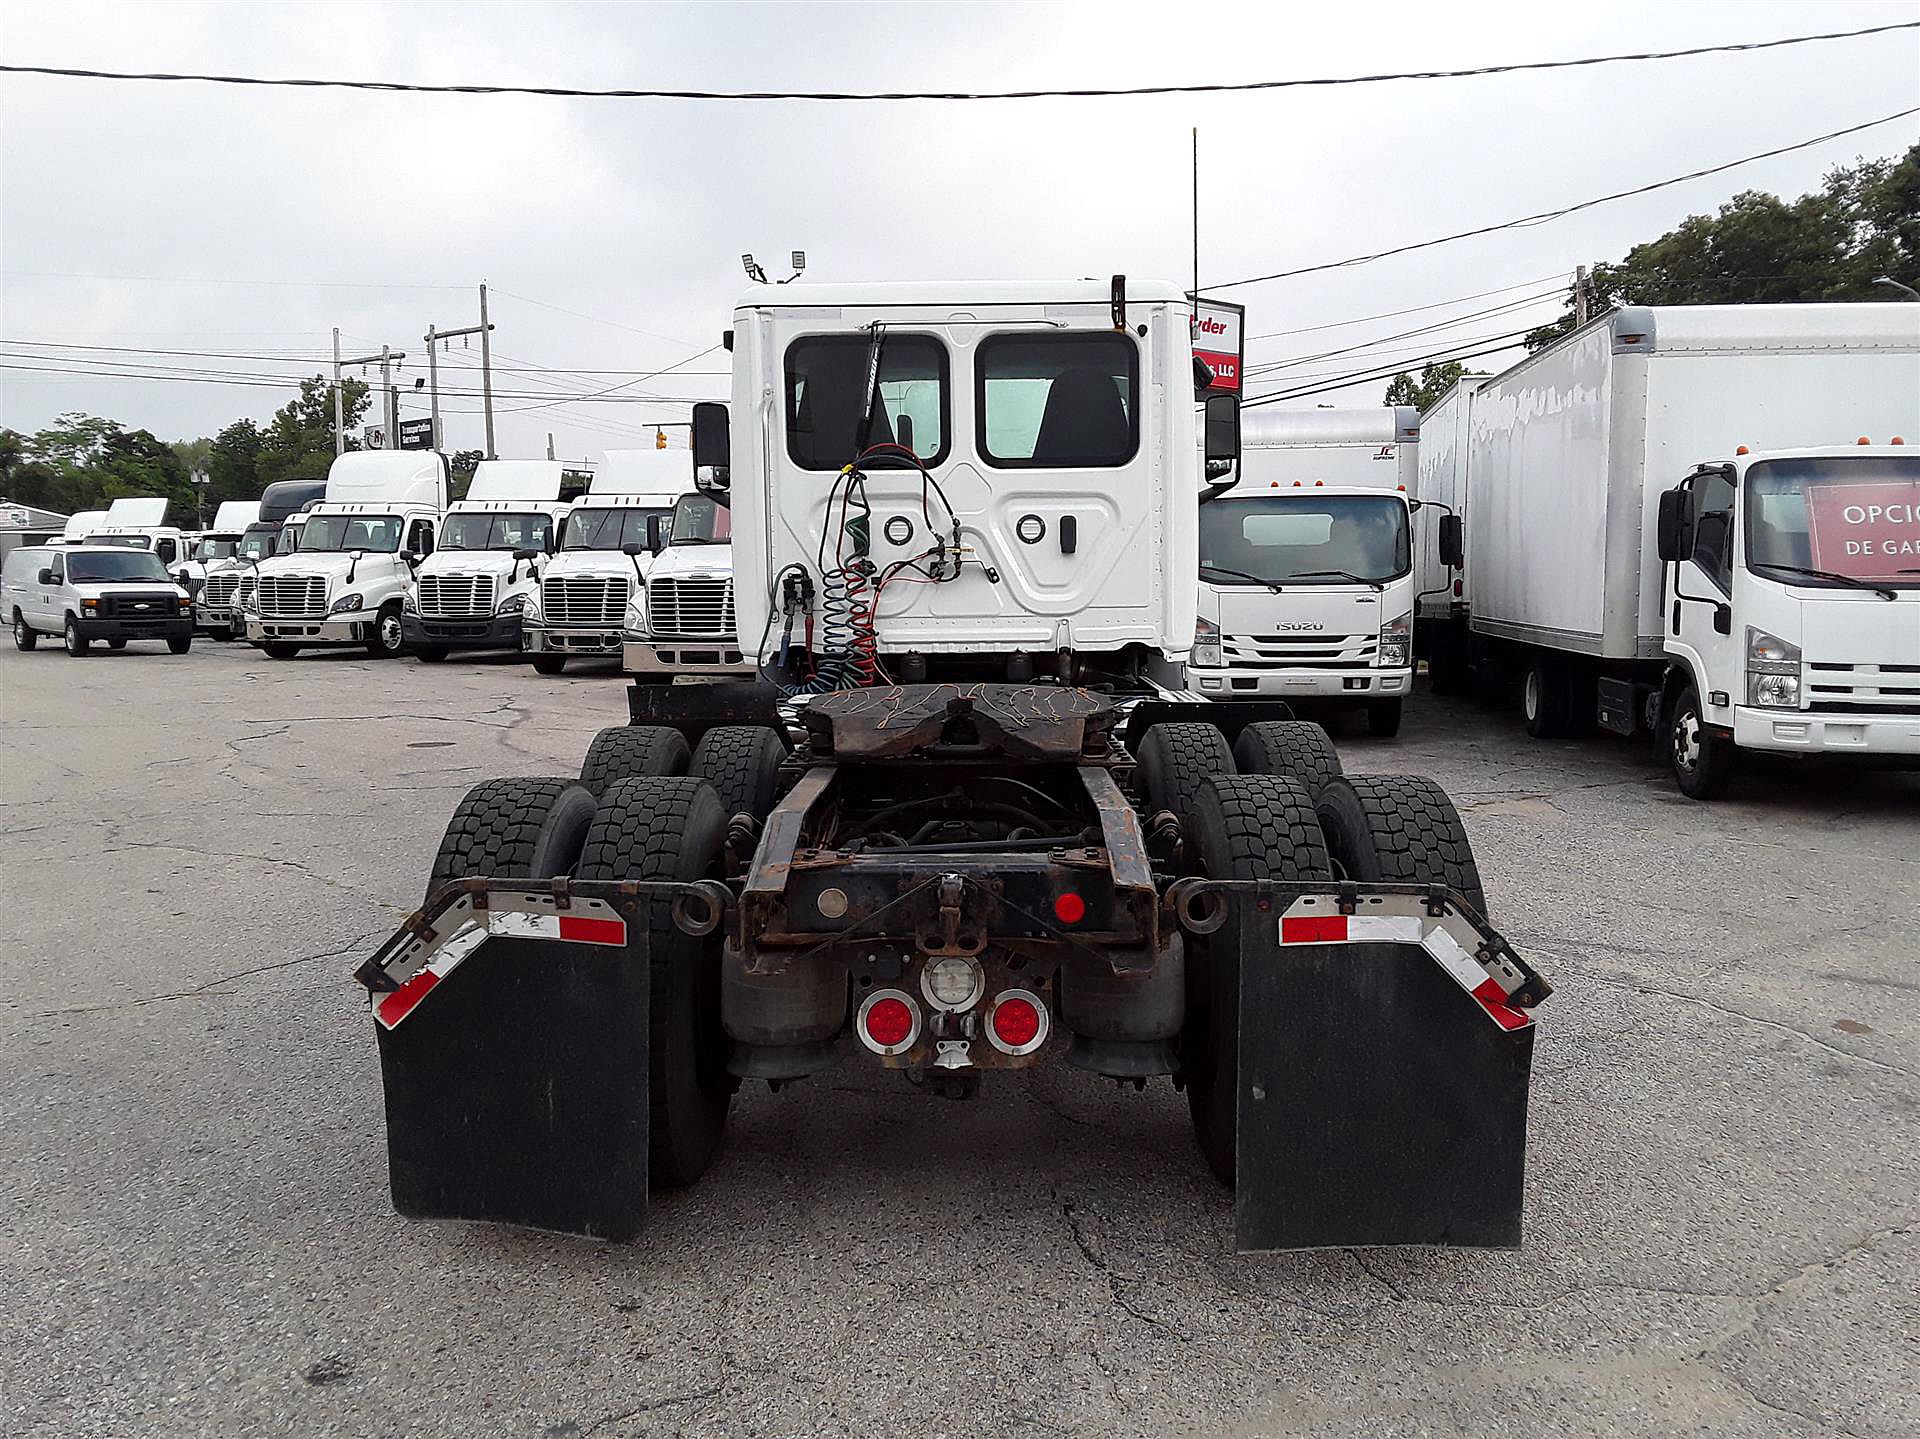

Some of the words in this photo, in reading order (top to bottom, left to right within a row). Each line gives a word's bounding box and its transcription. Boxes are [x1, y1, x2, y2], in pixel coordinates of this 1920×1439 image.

[1218, 363, 1235, 378] LLC
[1844, 504, 1920, 524] OPCI
[1846, 540, 1874, 555] DE
[1276, 621, 1324, 631] ISUZU
